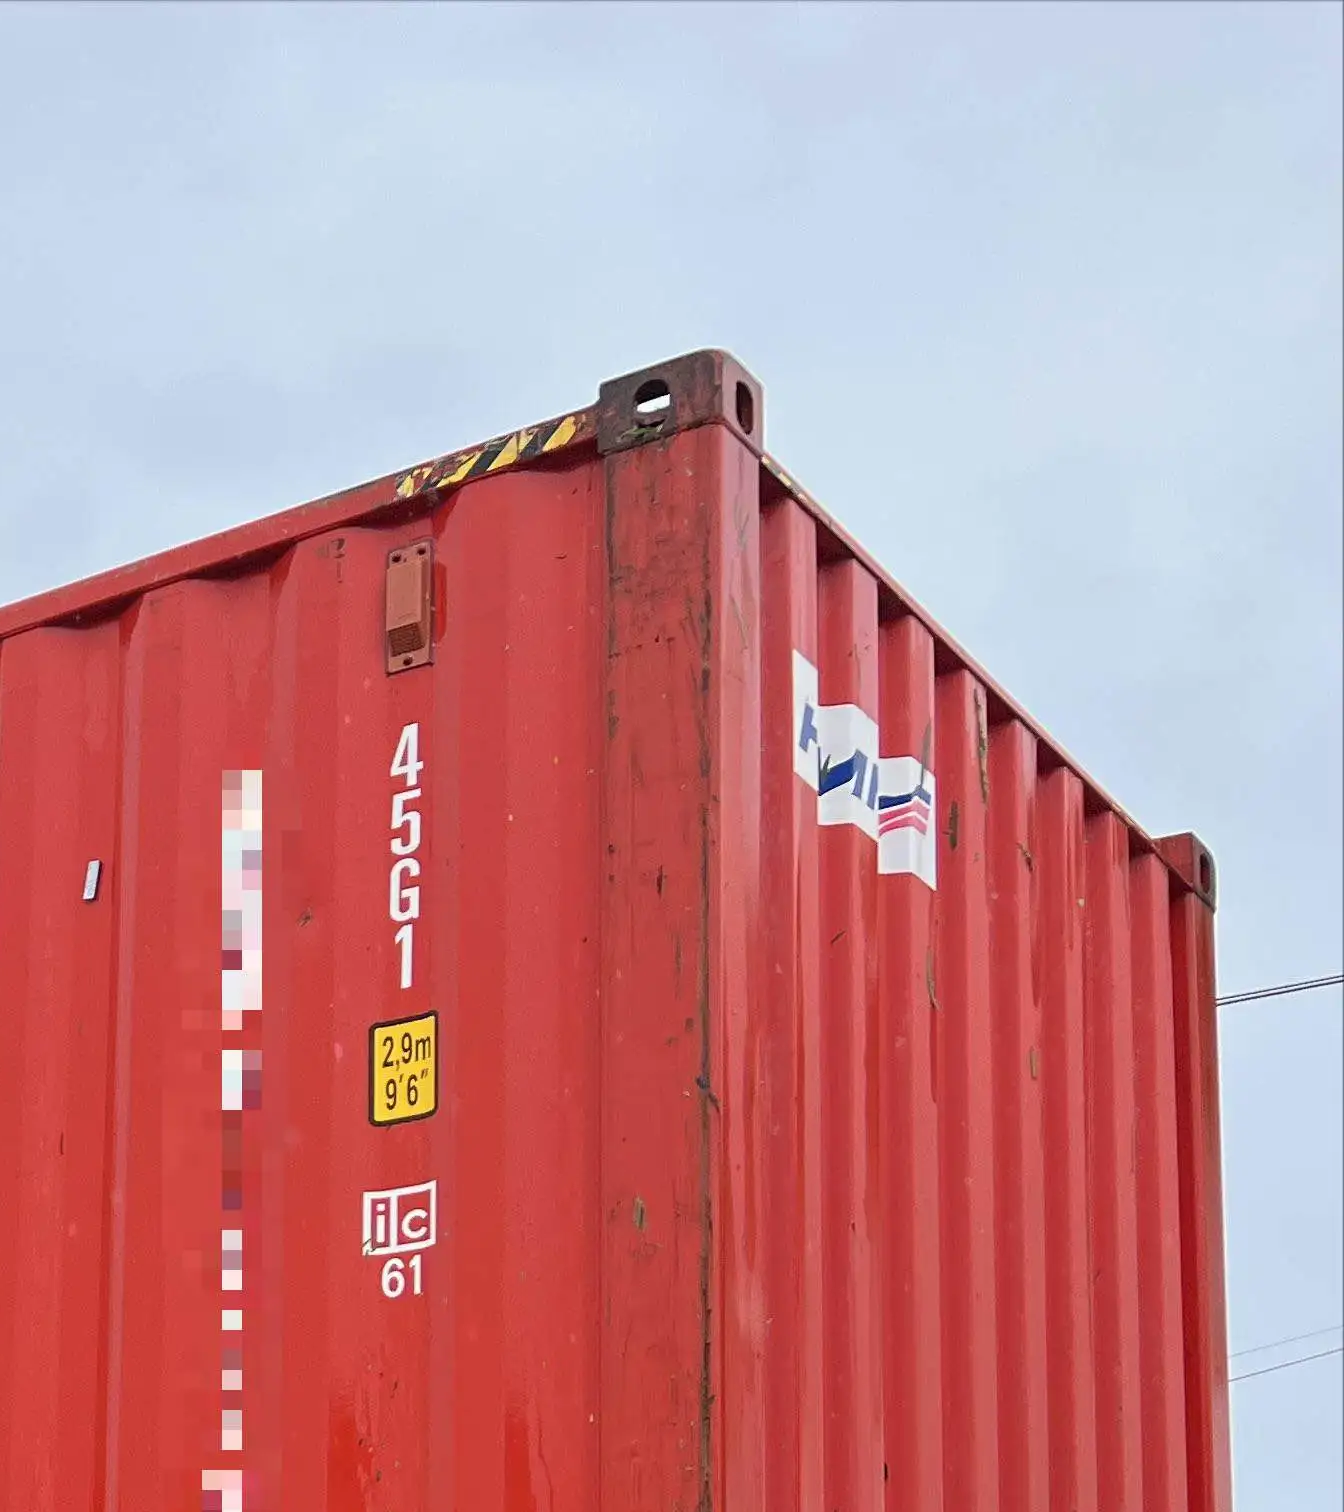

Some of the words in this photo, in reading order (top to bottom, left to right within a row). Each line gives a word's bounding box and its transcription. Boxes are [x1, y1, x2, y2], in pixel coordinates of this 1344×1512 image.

[389, 722, 424, 989] 45G1
[381, 1032, 431, 1070] 2,9m
[380, 1254, 423, 1299] 61
